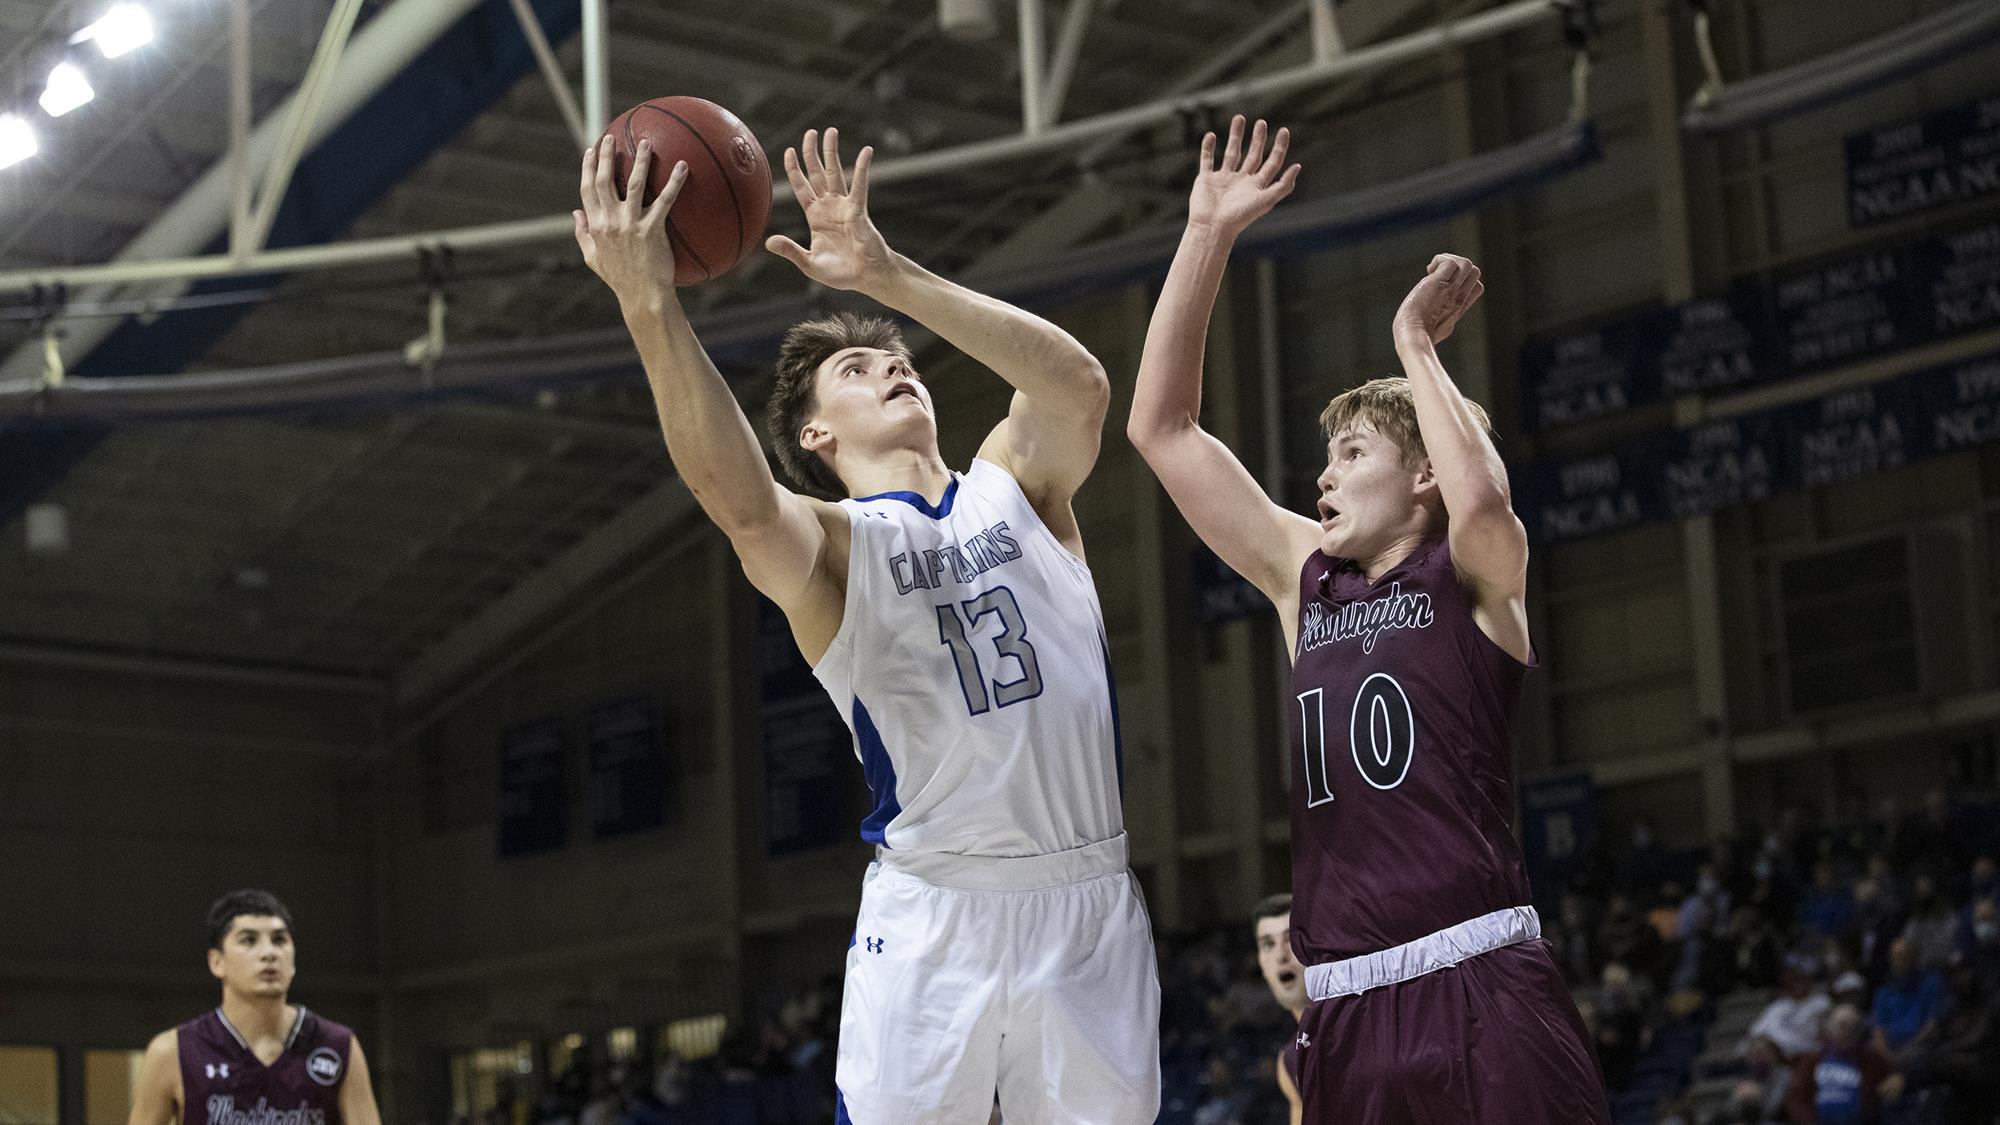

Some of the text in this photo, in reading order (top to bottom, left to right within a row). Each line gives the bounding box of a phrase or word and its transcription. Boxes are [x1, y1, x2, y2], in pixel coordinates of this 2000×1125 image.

[1852, 172, 1953, 223] NCAA
[1541, 492, 1640, 541] NCAA
[889, 520, 1023, 596] CAPTAINS
[935, 585, 1044, 716] 13
[1297, 672, 1415, 809] 10
